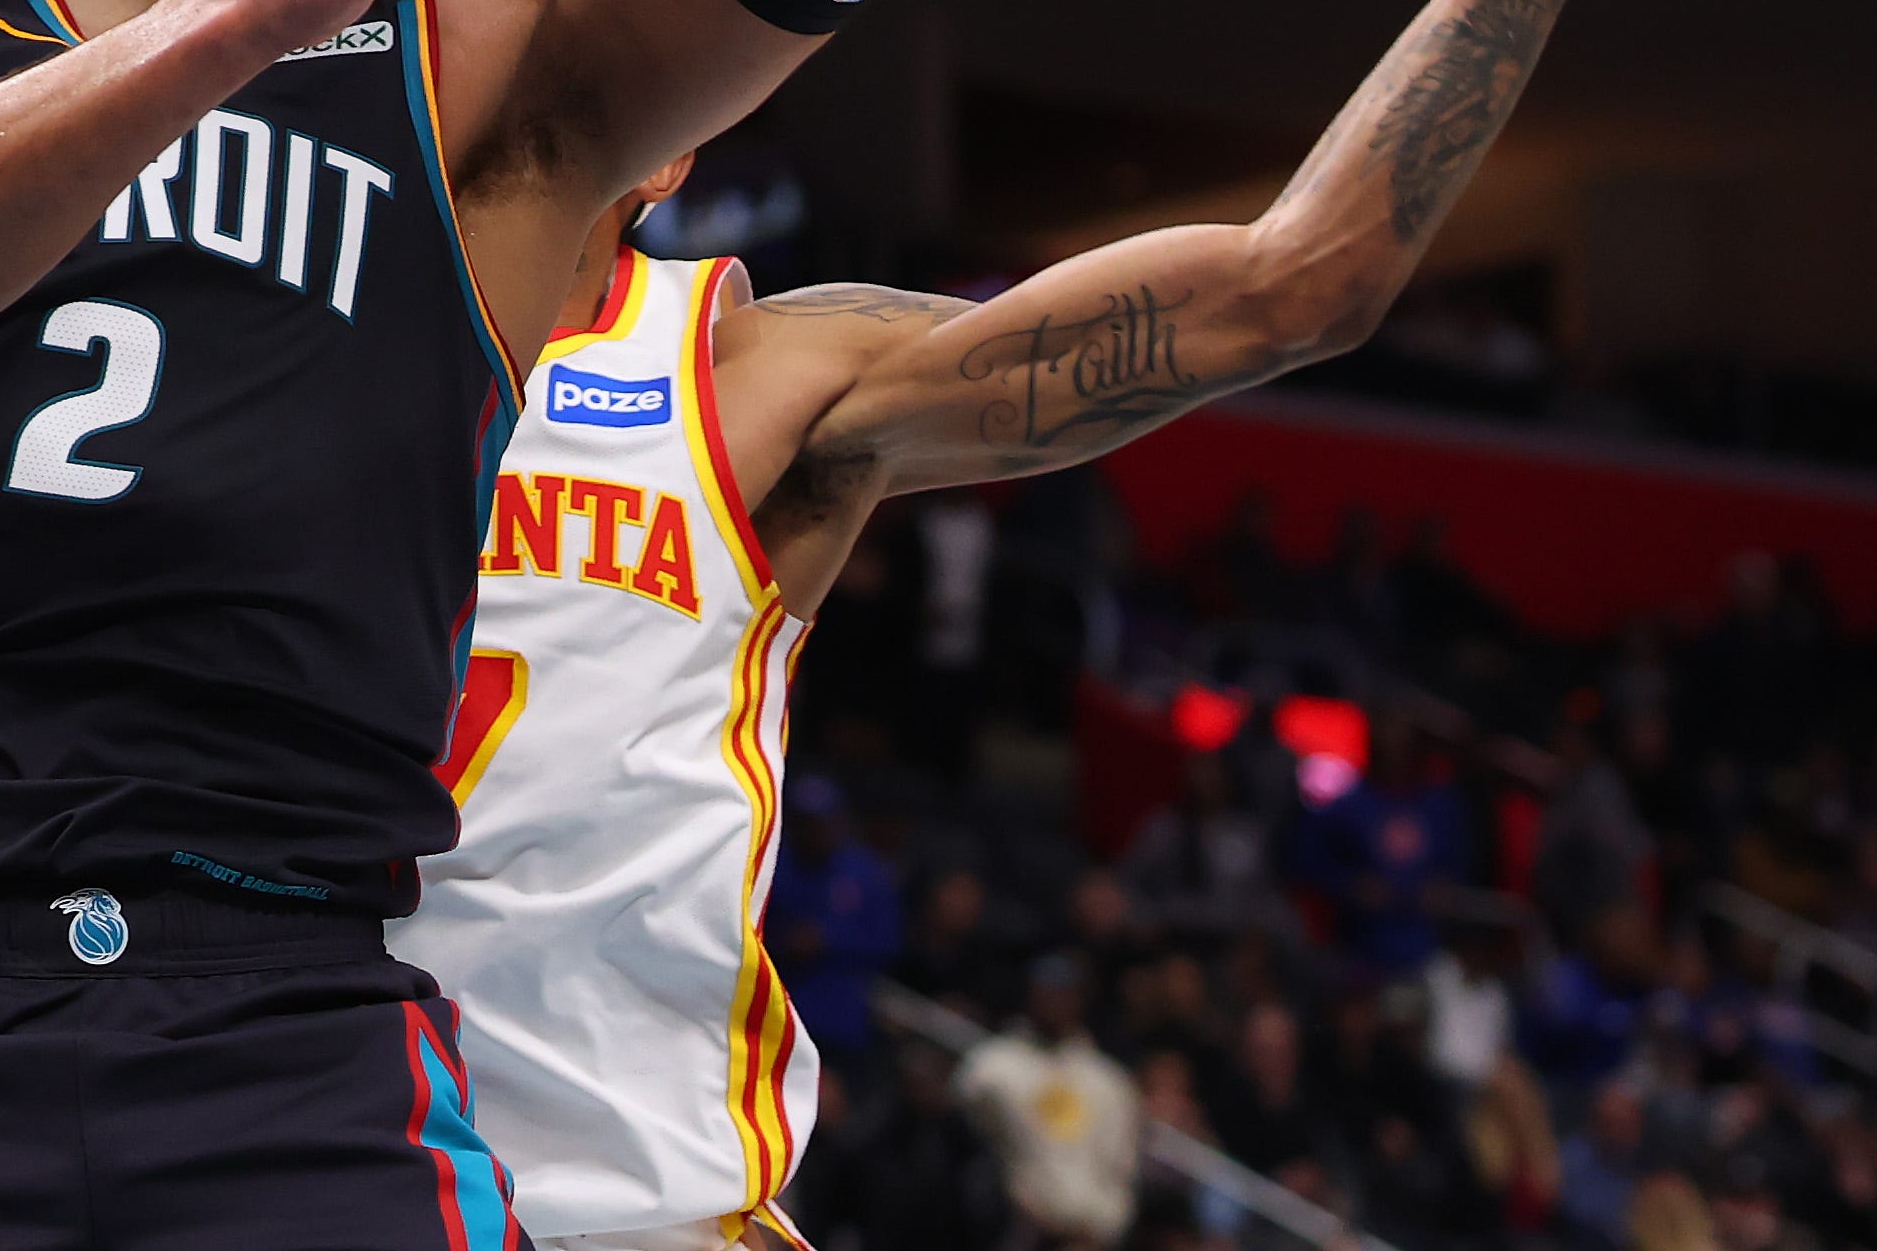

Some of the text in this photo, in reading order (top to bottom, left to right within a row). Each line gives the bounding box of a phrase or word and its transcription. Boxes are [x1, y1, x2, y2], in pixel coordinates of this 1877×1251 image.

[4, 298, 166, 505] 2
[554, 380, 664, 413] paze
[172, 851, 242, 884] DETROIT
